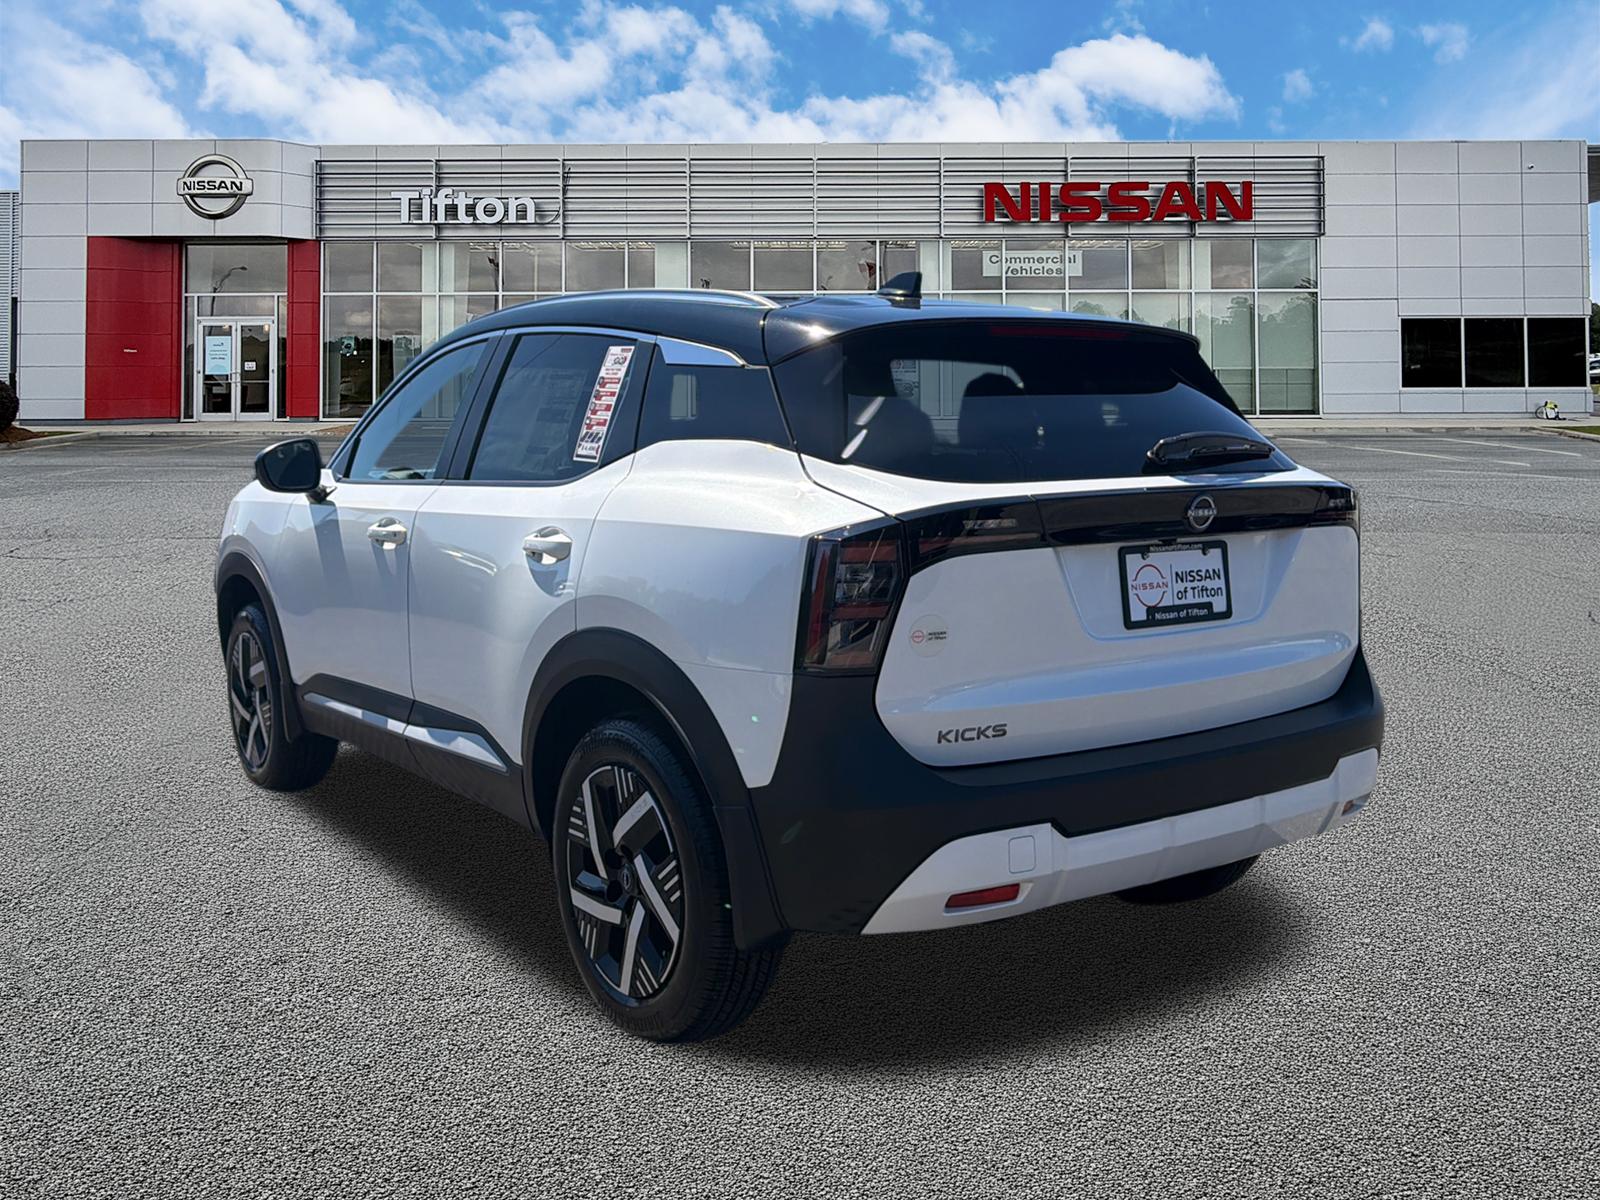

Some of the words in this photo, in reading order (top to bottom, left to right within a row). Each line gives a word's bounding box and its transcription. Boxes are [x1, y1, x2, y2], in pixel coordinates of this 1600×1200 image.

[182, 180, 243, 191] NISSAN
[391, 188, 536, 224] Tifton
[983, 181, 1253, 222] NISSAN
[1174, 567, 1221, 584] NISSAN
[1131, 580, 1168, 592] NISSAN
[1176, 586, 1188, 601] of
[1190, 585, 1223, 599] Tifton
[1154, 611, 1178, 620] Nissan
[1179, 608, 1187, 618] of
[1188, 607, 1209, 617] Tifton
[937, 723, 1008, 744] KICKS
